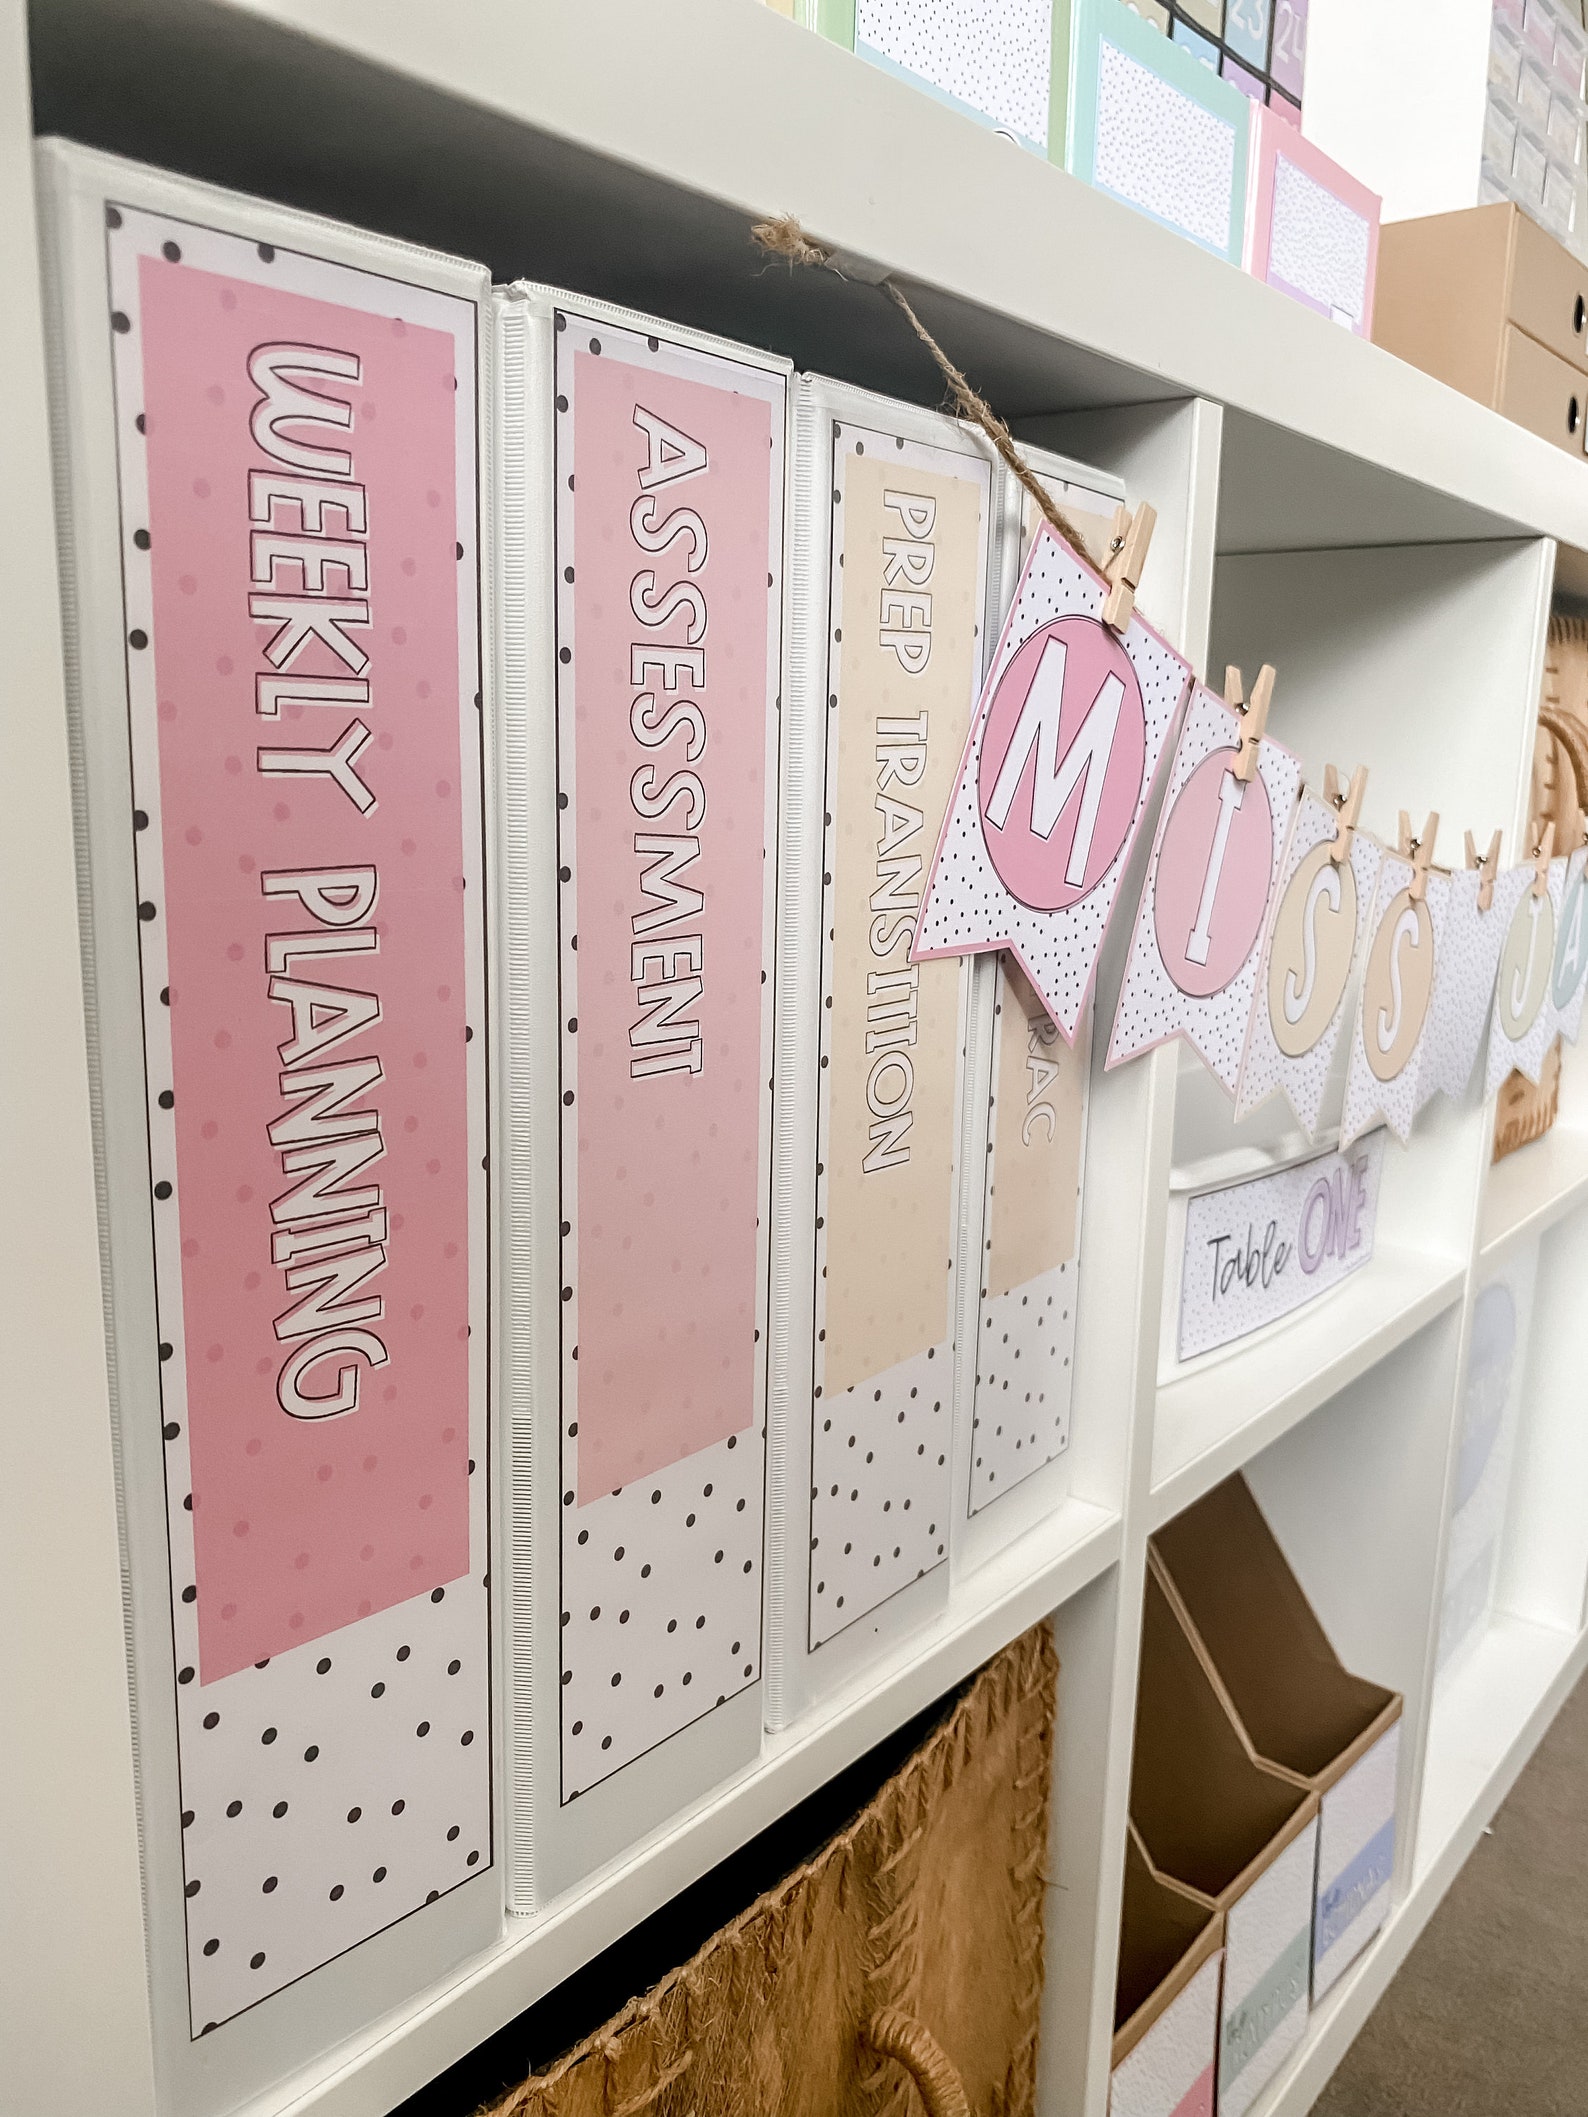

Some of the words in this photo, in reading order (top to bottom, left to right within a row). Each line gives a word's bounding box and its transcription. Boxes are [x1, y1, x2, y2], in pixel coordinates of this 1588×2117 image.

[247, 341, 379, 819] WEEKLY
[629, 404, 709, 1082] ASSESSMENT
[879, 488, 937, 676] PREP
[261, 864, 389, 1423] PLANNING
[861, 709, 929, 1174] TRANSITION
[1021, 990, 1060, 1148] RAC
[1206, 1219, 1294, 1304] Table
[1298, 1153, 1369, 1275] ONE
